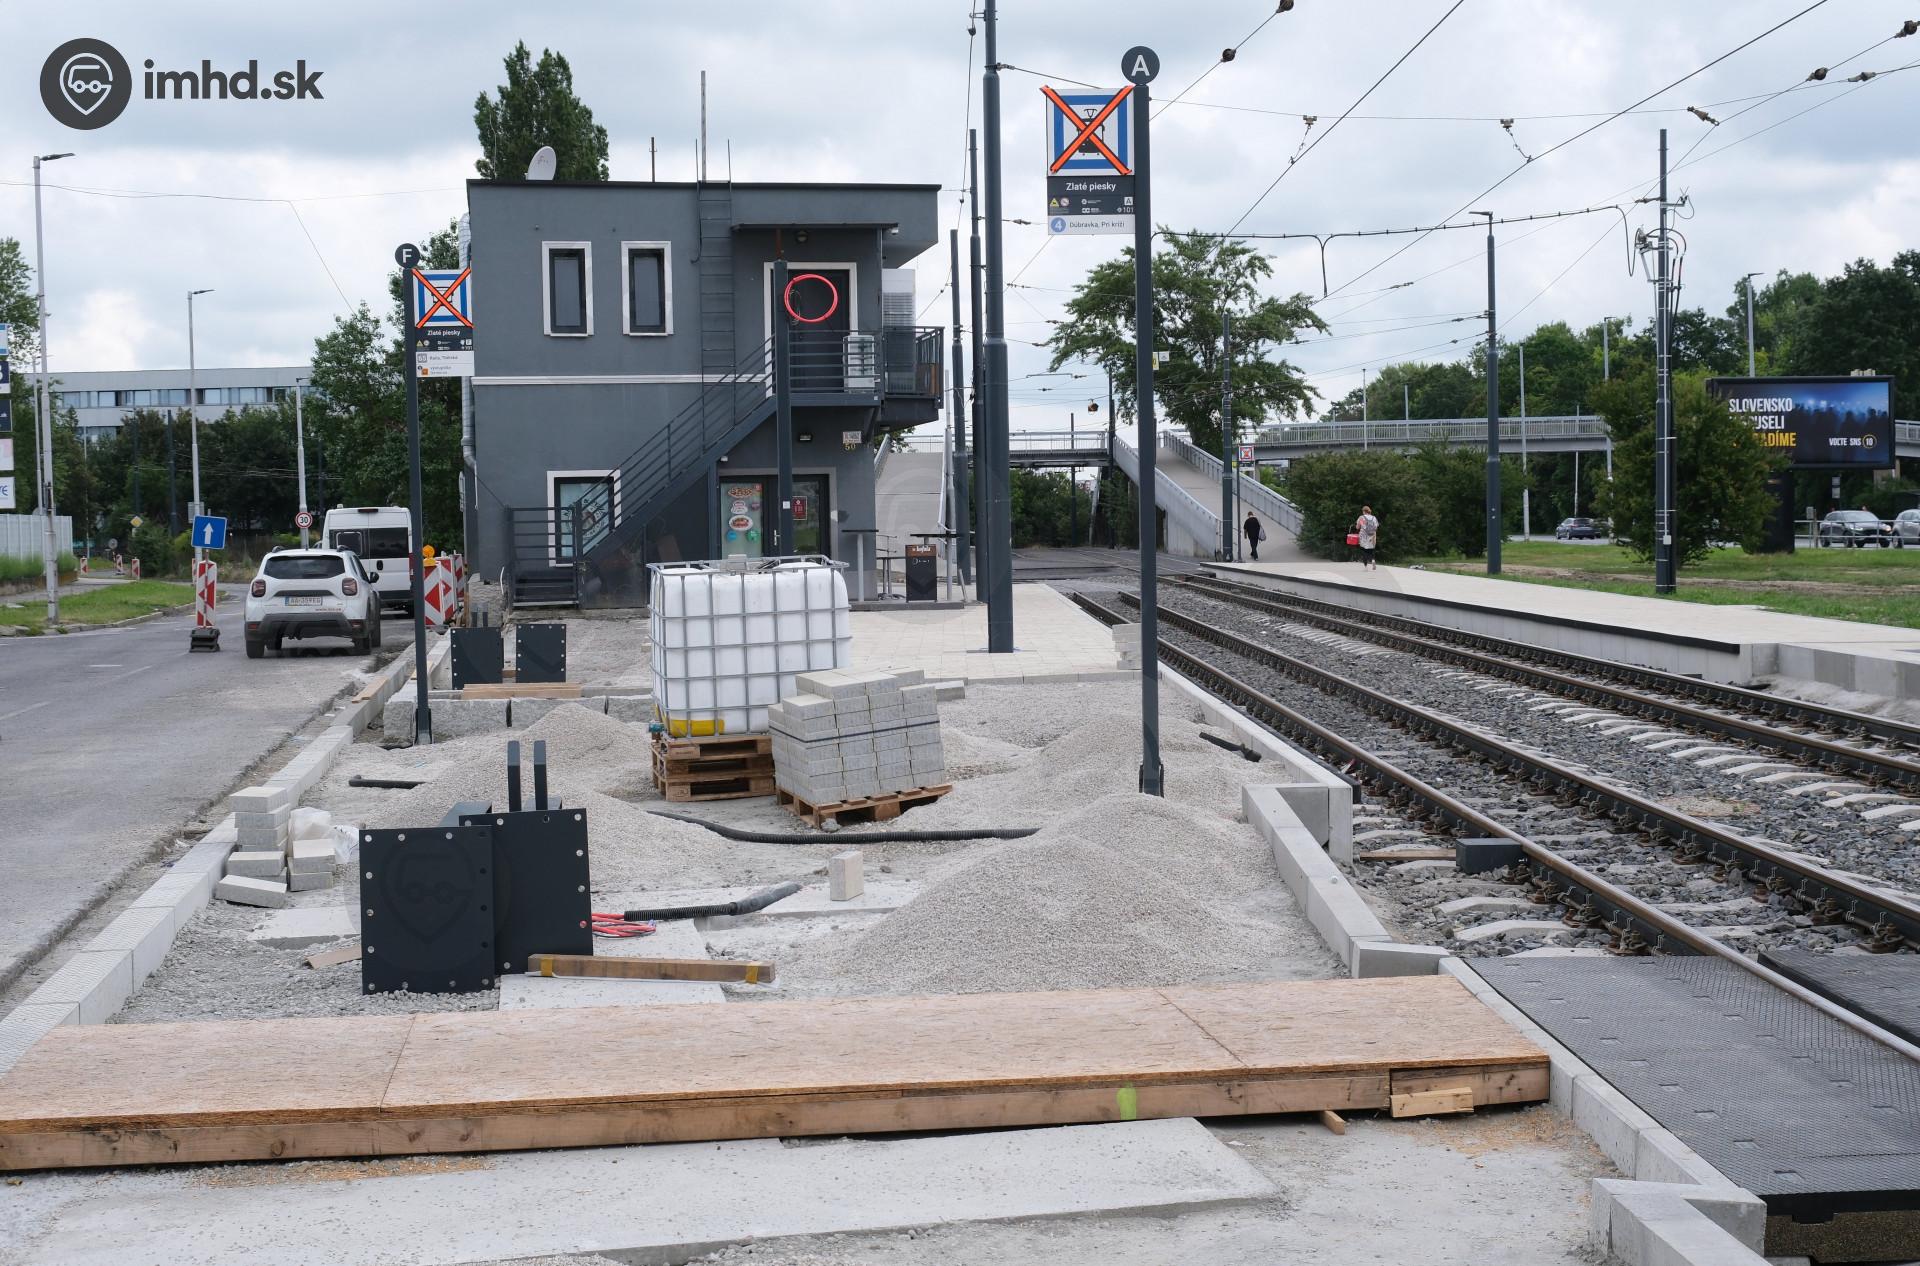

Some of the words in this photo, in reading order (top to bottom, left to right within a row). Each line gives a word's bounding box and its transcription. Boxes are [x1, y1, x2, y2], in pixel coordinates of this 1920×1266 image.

[1131, 55, 1150, 77] A
[1066, 182, 1088, 191] Zlaté
[1089, 182, 1117, 192] piesky
[1055, 220, 1063, 230] 4
[402, 248, 412, 263] F
[1729, 398, 1793, 412] SLOVENSKO
[1849, 437, 1862, 446] SNS
[1866, 437, 1874, 446] 10
[300, 516, 309, 524] 30
